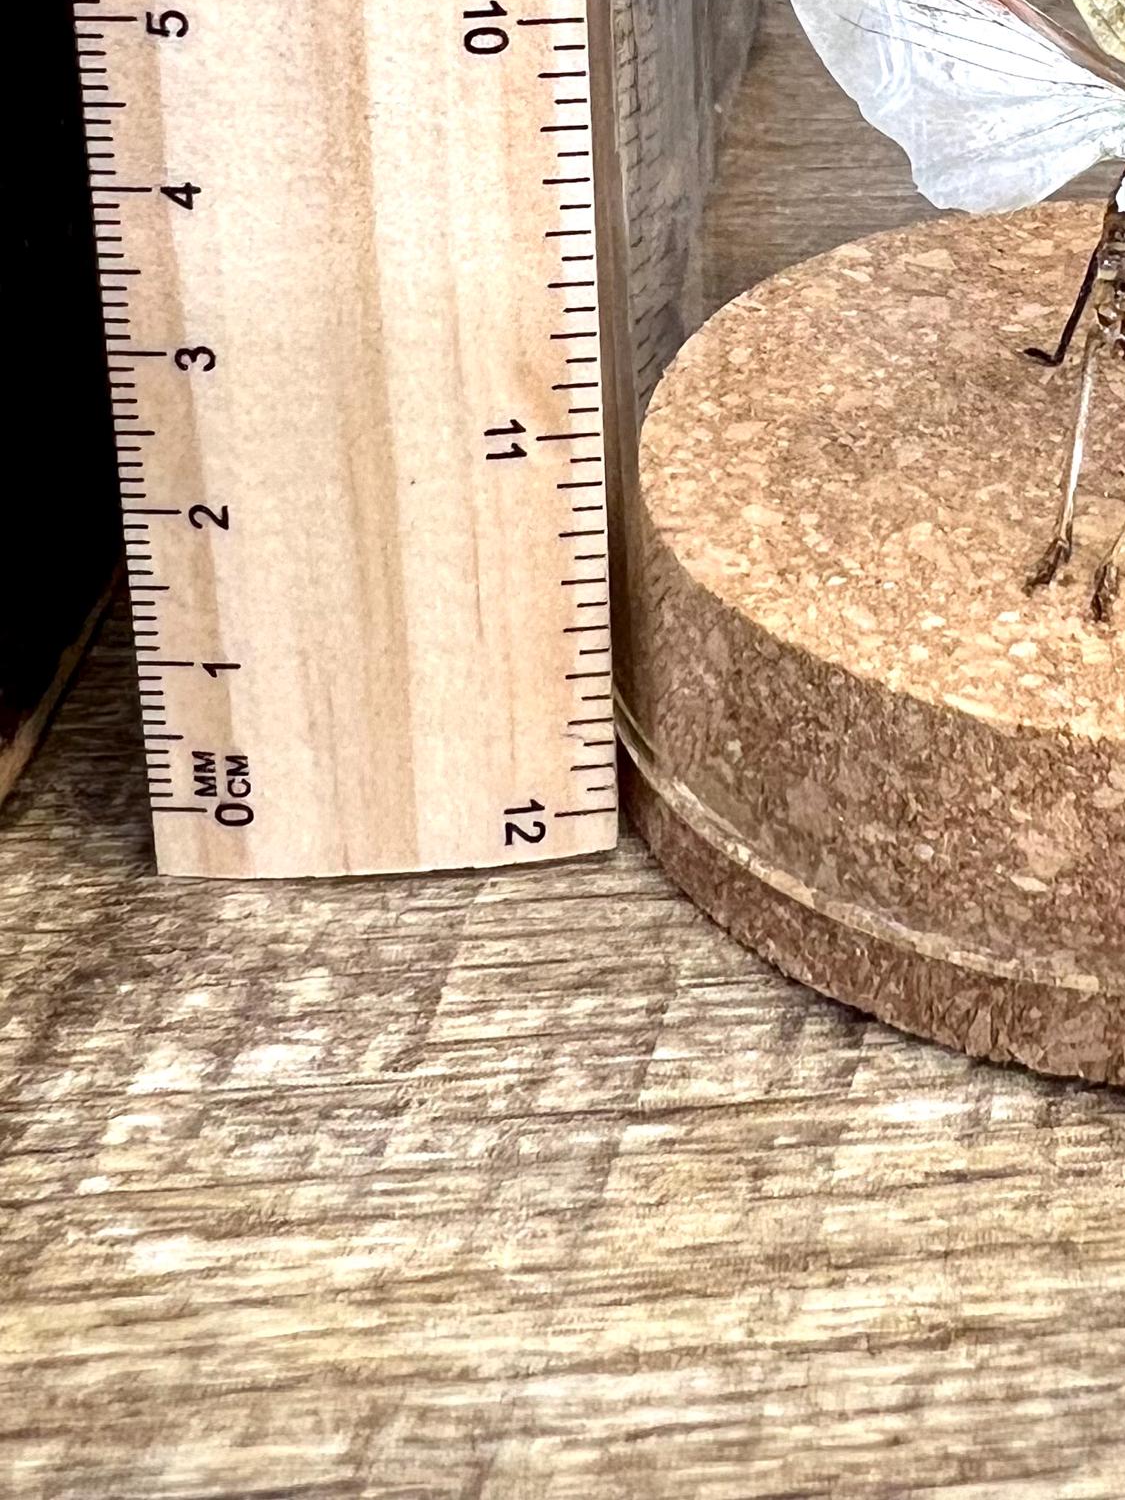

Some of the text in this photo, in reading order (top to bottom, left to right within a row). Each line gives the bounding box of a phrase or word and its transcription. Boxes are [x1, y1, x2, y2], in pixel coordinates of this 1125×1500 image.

[145, 9, 190, 39] 5
[463, 0, 511, 56] 10
[159, 181, 202, 211] 4
[173, 344, 217, 373] 3
[482, 418, 528, 461] 11
[187, 503, 231, 532] 2
[201, 661, 243, 680] 1
[191, 750, 218, 798] MM
[503, 797, 547, 847] 12
